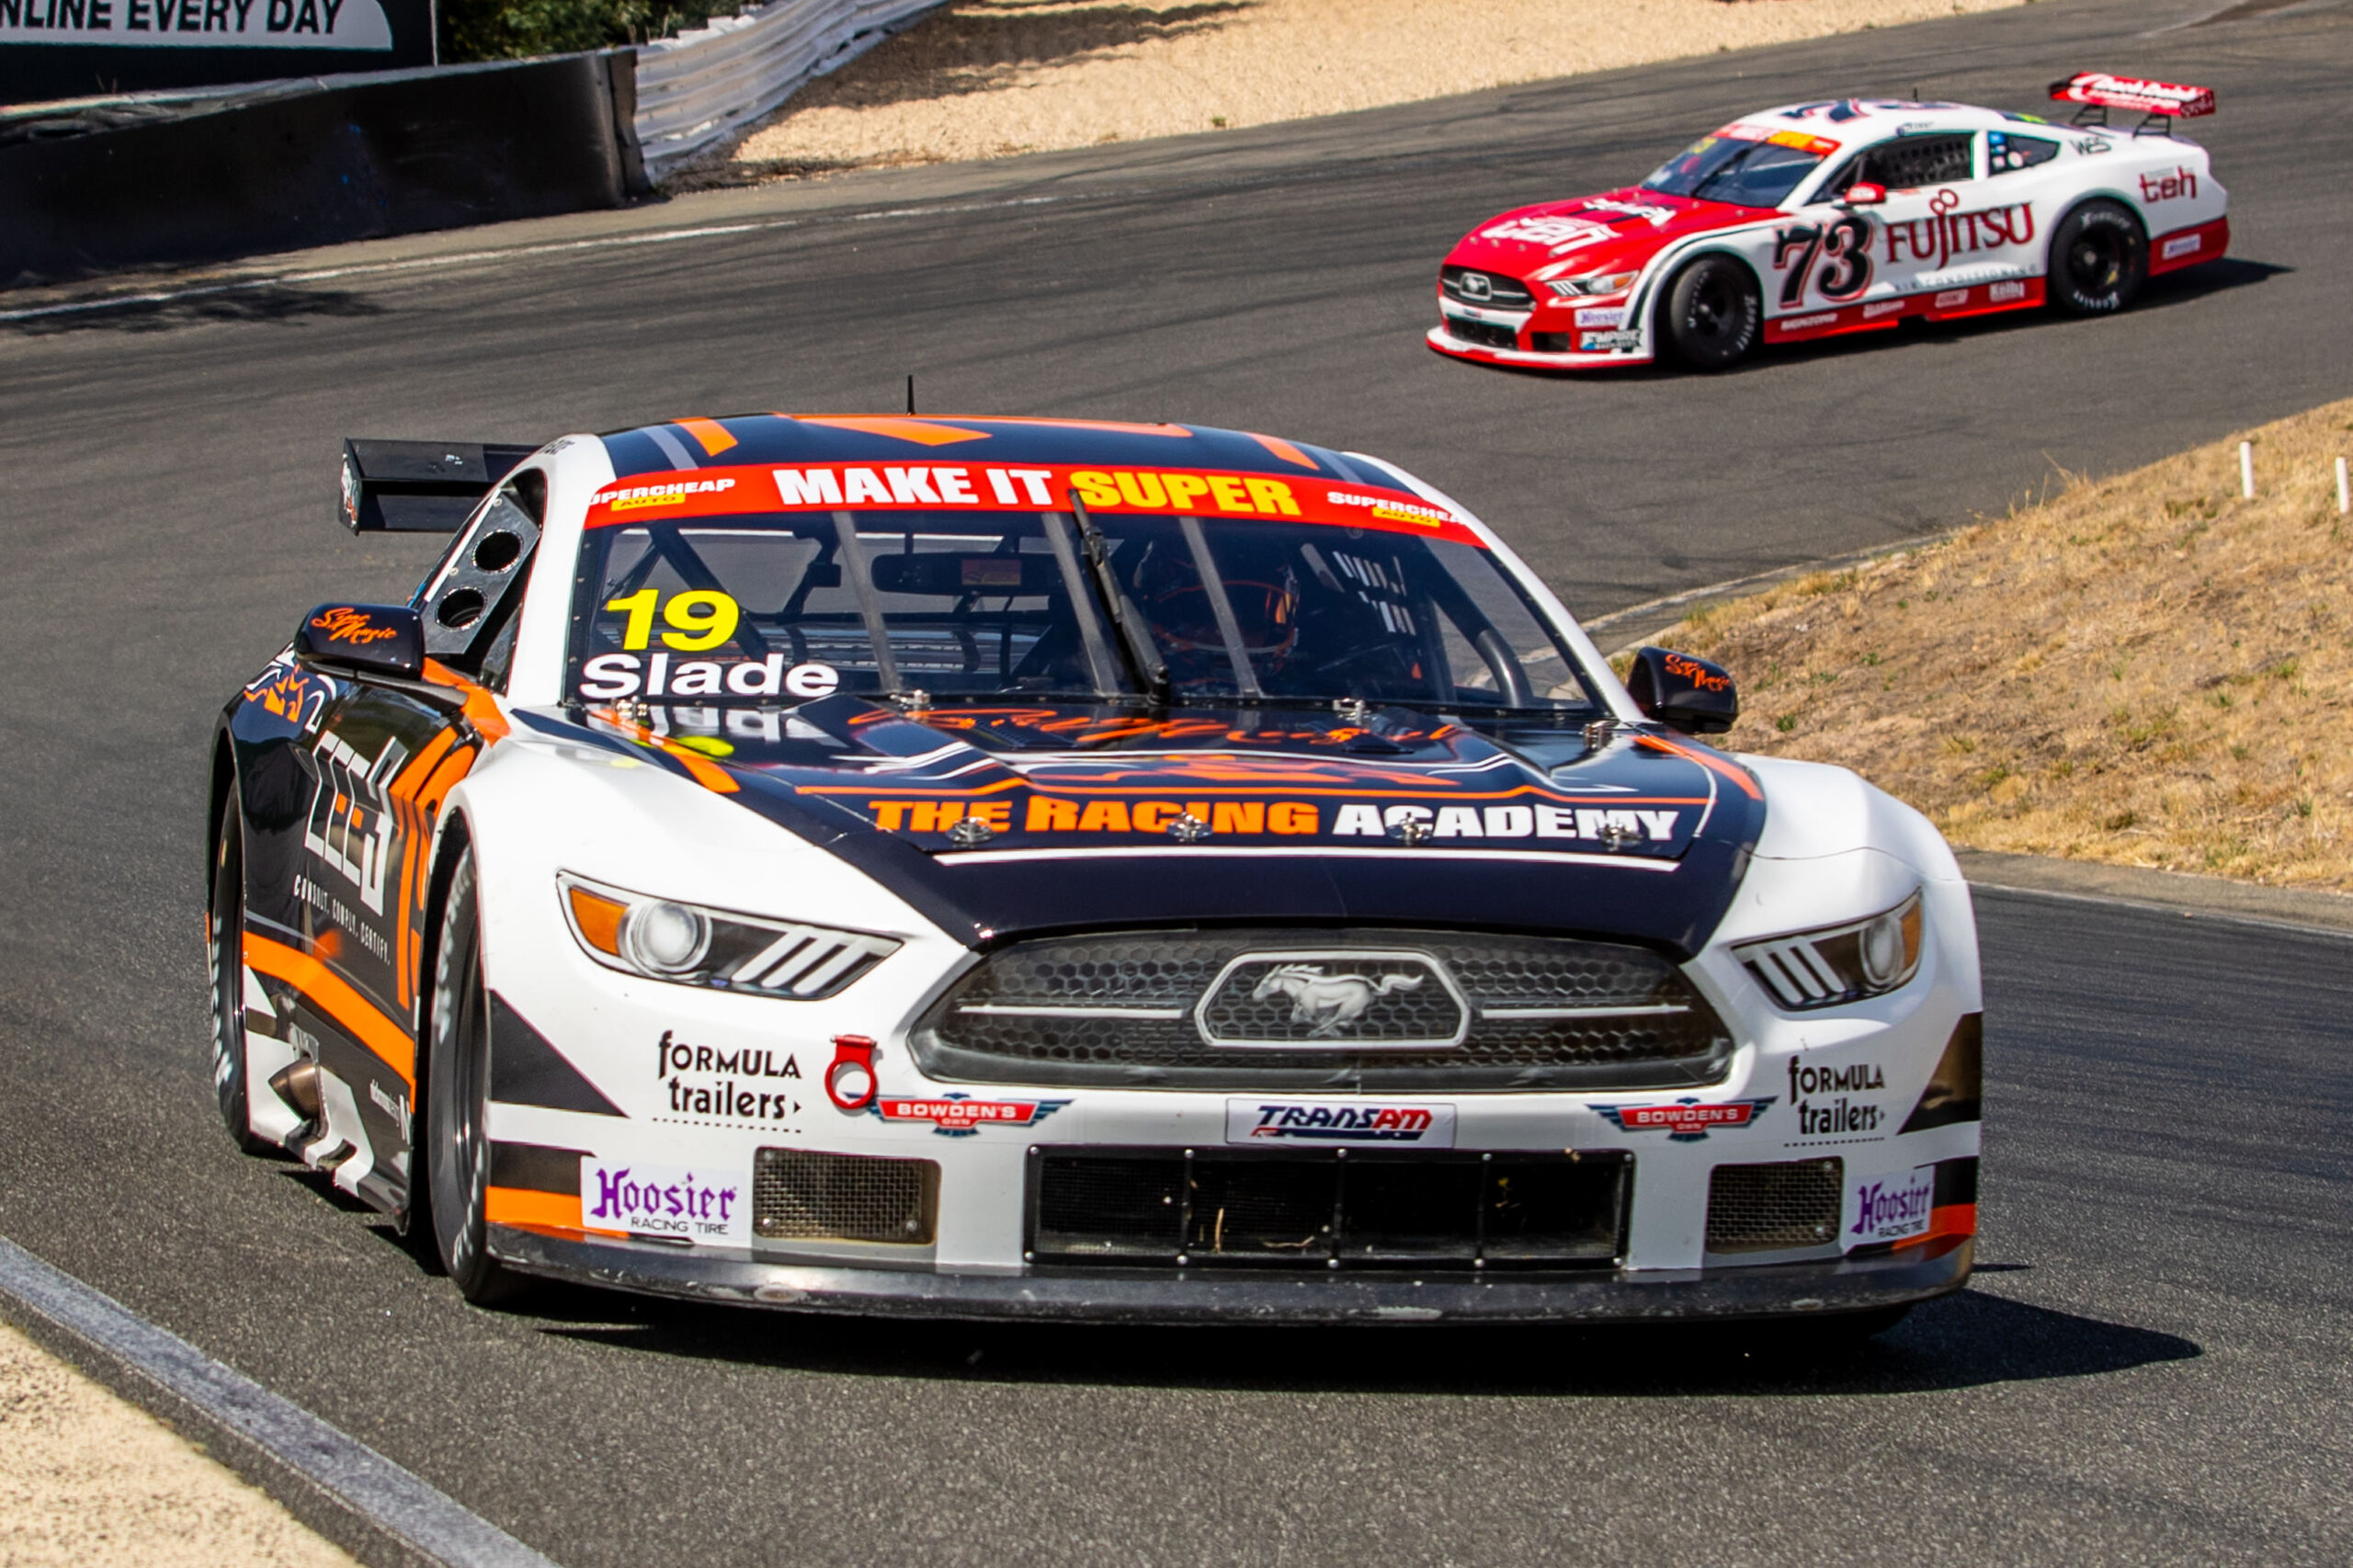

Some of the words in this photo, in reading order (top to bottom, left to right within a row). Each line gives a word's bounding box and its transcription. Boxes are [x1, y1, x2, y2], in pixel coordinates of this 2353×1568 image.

[127, 0, 252, 33] EVERY
[267, 0, 345, 34] DAY
[1885, 190, 2035, 269] FUJITSU
[1772, 211, 1873, 310] 73
[773, 467, 980, 506] MAKE
[988, 469, 1052, 506] IT
[1070, 472, 1302, 516] SUPER
[607, 588, 739, 652] 19
[580, 653, 839, 699] Slade
[869, 801, 1012, 833] THE
[1025, 796, 1319, 835] RACING
[1333, 803, 1679, 841] ACADEMY
[668, 1075, 786, 1120] trailers
[896, 1103, 1017, 1119] BOWDEN'S
[1637, 1108, 1739, 1124] BOWDEN'S
[1798, 1101, 1878, 1136] trailers
[590, 1167, 737, 1221] Hoosier
[1850, 1173, 1929, 1234] Hoosier
[631, 1217, 688, 1233] RACING
[695, 1221, 729, 1235] TIRE
